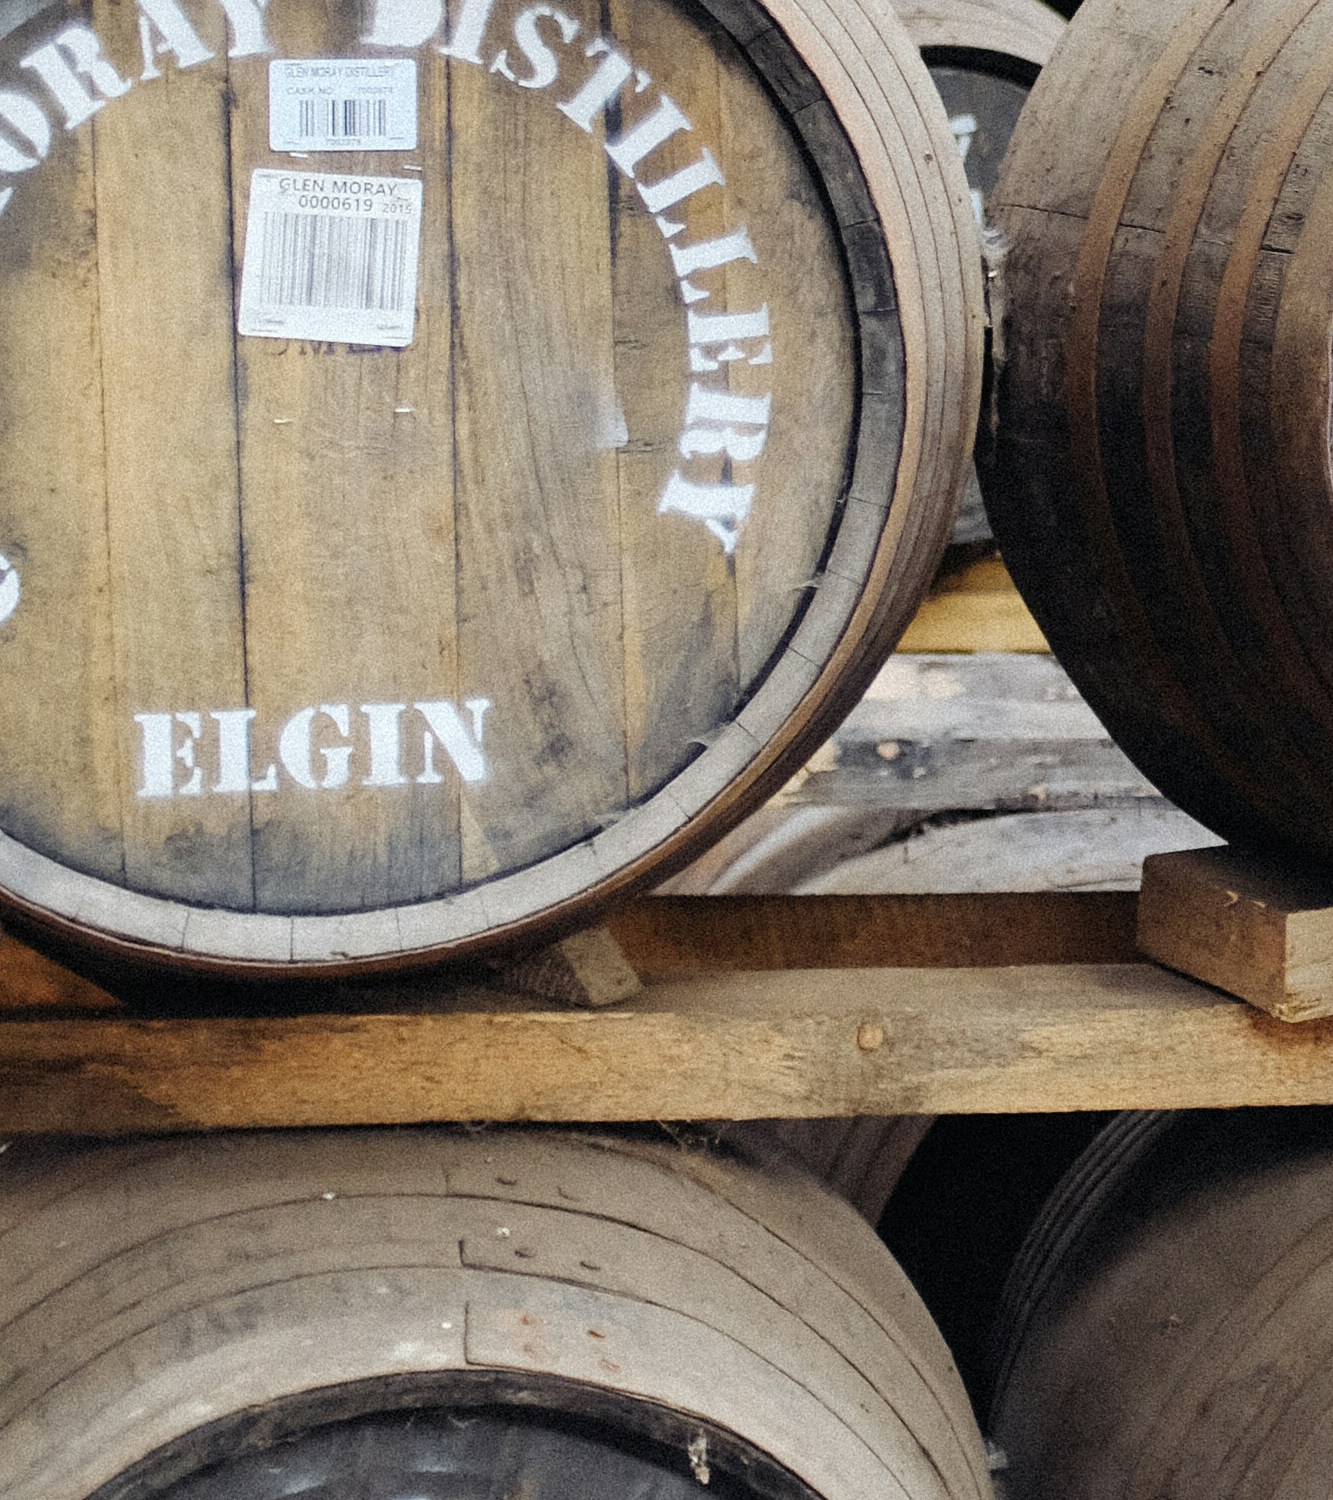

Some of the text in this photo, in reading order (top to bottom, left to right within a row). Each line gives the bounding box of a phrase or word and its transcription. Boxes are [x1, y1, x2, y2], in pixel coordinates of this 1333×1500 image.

[279, 177, 397, 196] GLEN MORAY
[299, 194, 413, 215] 0000619 2015
[133, 698, 492, 798] ELGIN
